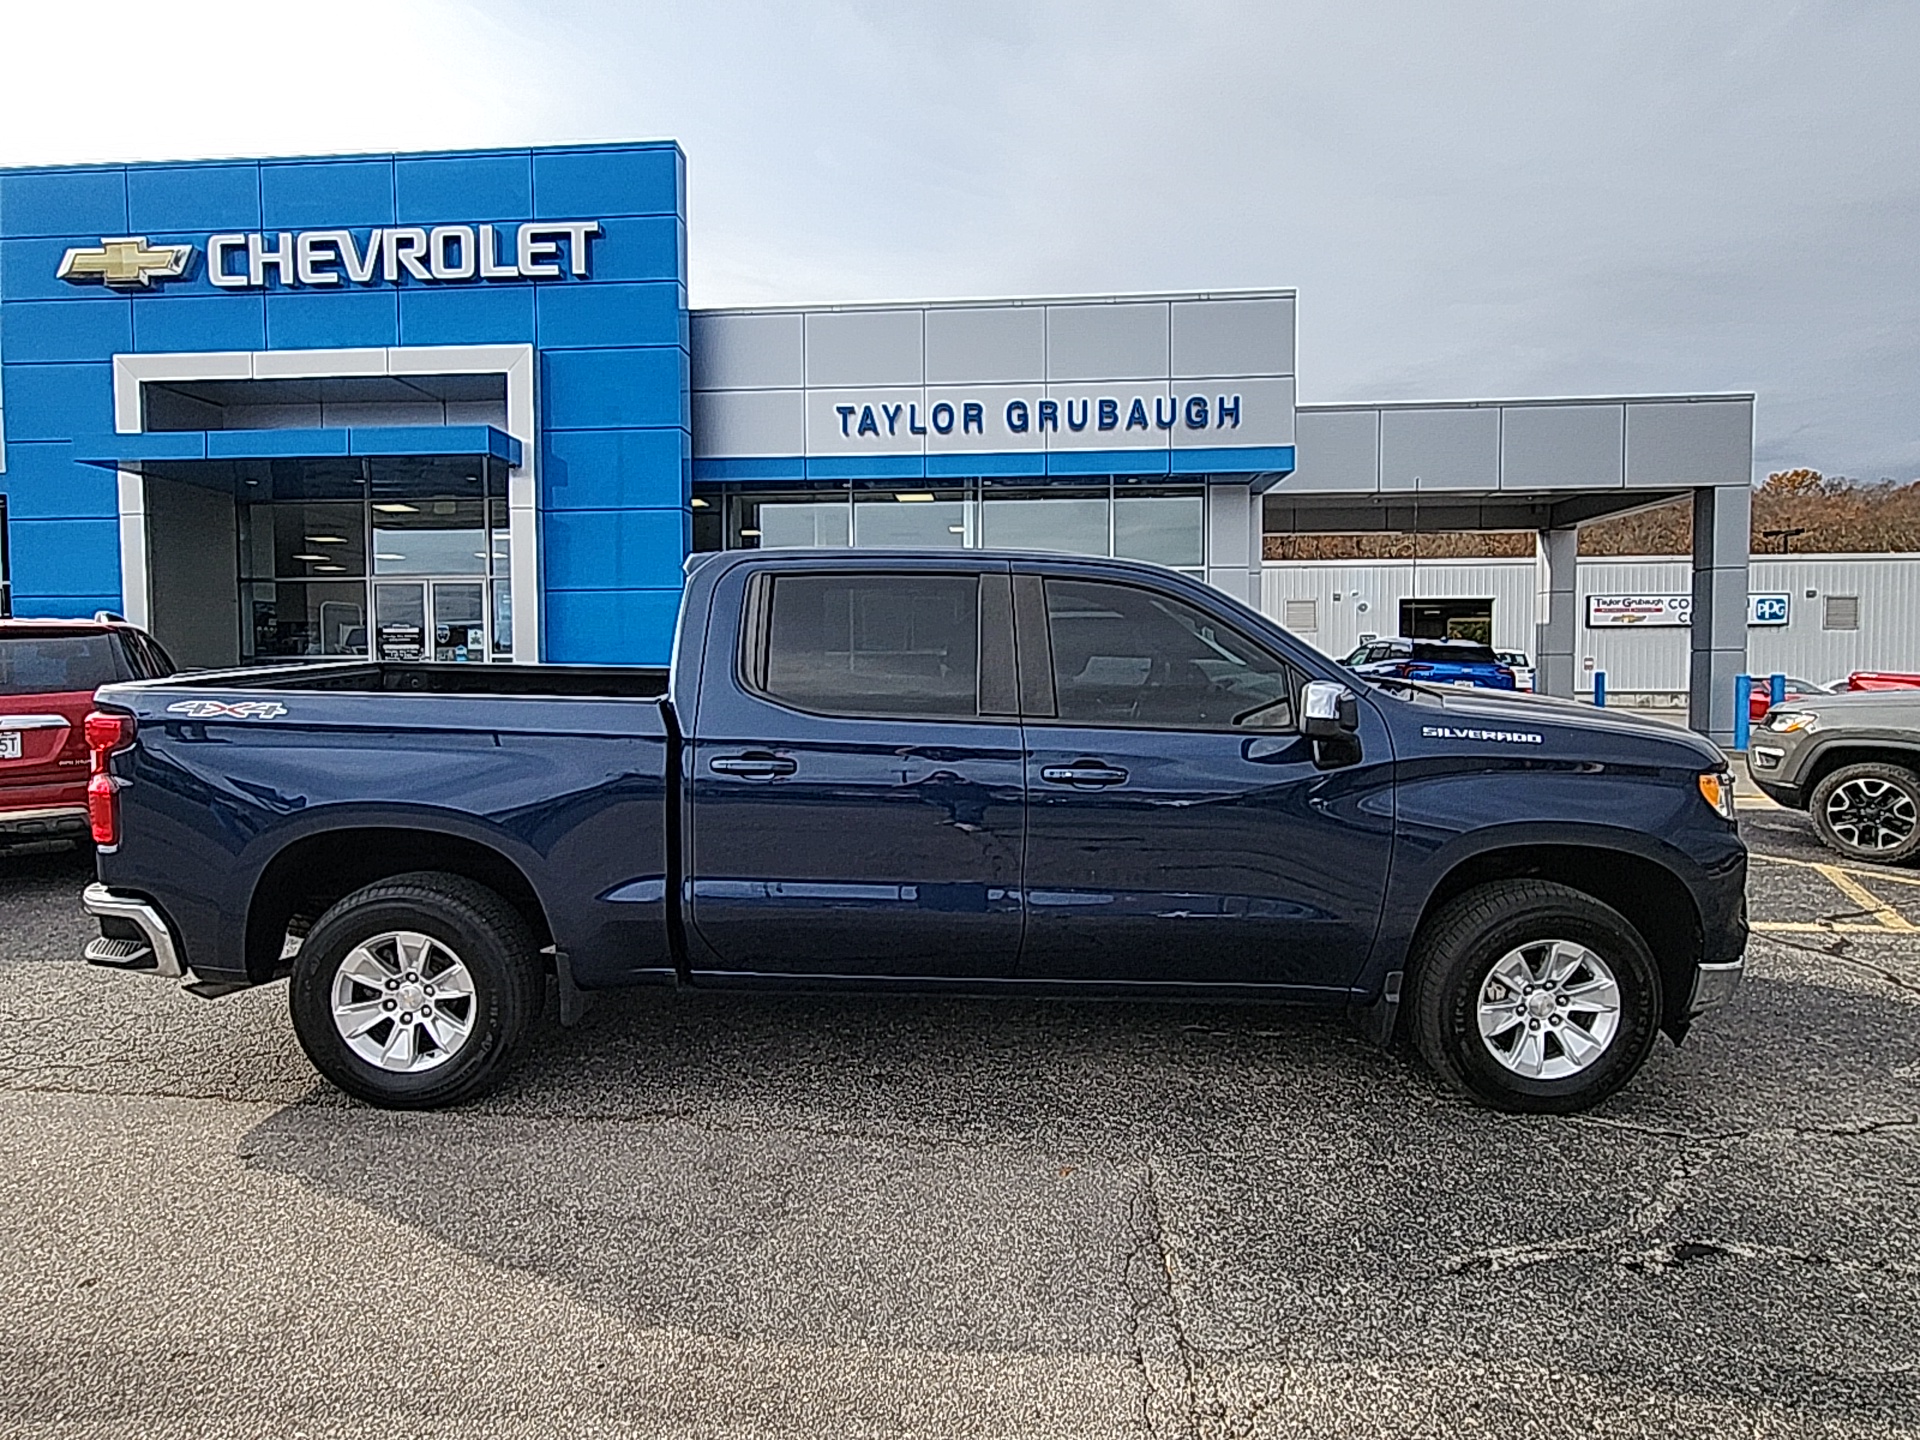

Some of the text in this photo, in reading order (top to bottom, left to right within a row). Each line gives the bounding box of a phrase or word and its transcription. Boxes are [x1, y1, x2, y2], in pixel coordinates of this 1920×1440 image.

[207, 221, 600, 287] CHEVROLET
[836, 396, 1242, 436] TAYLOR GRUBAUGH
[1594, 598, 1621, 608] Taylor
[1757, 600, 1785, 619] PPG
[1422, 726, 1543, 744] SILVERADO
